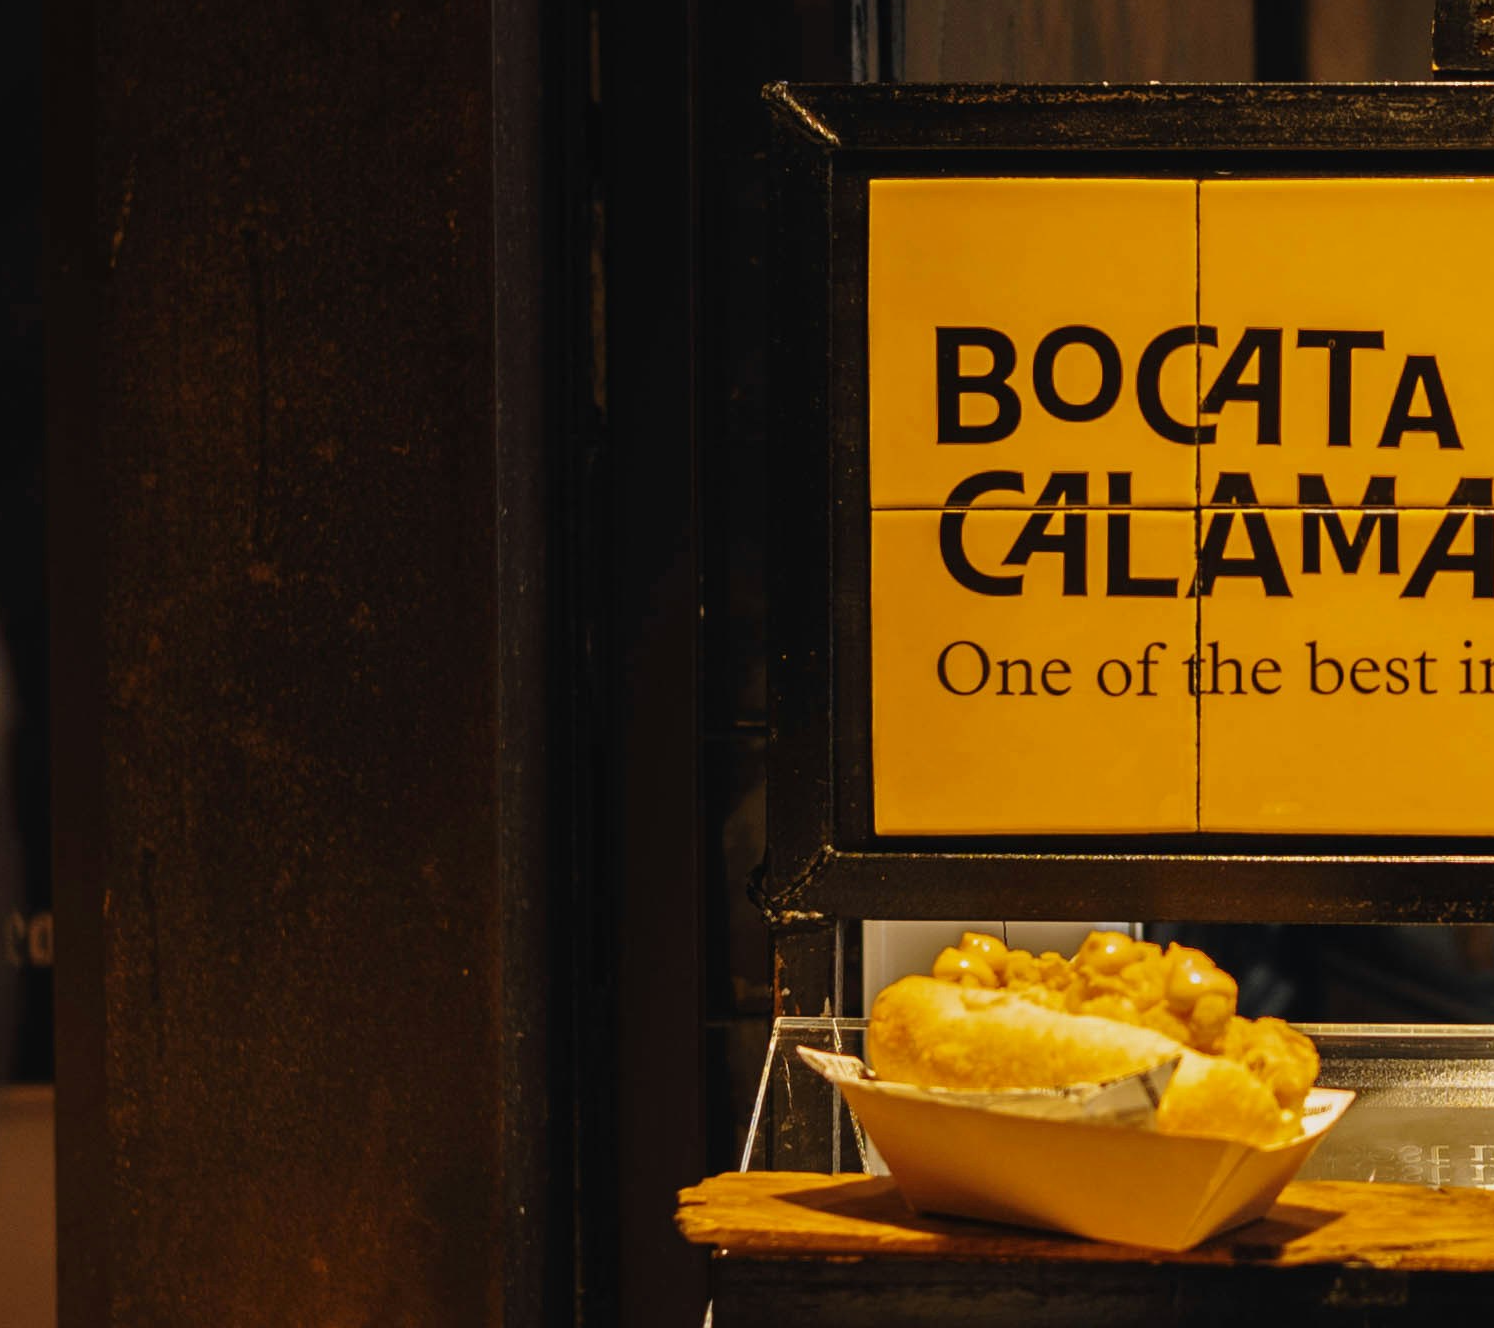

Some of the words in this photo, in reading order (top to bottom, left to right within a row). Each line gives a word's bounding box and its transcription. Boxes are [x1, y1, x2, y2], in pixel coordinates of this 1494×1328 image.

[933, 324, 1465, 450] BOCATA
[935, 639, 1074, 698] One
[1095, 641, 1167, 698] of
[1184, 642, 1283, 697] the
[1305, 641, 1439, 697] best
